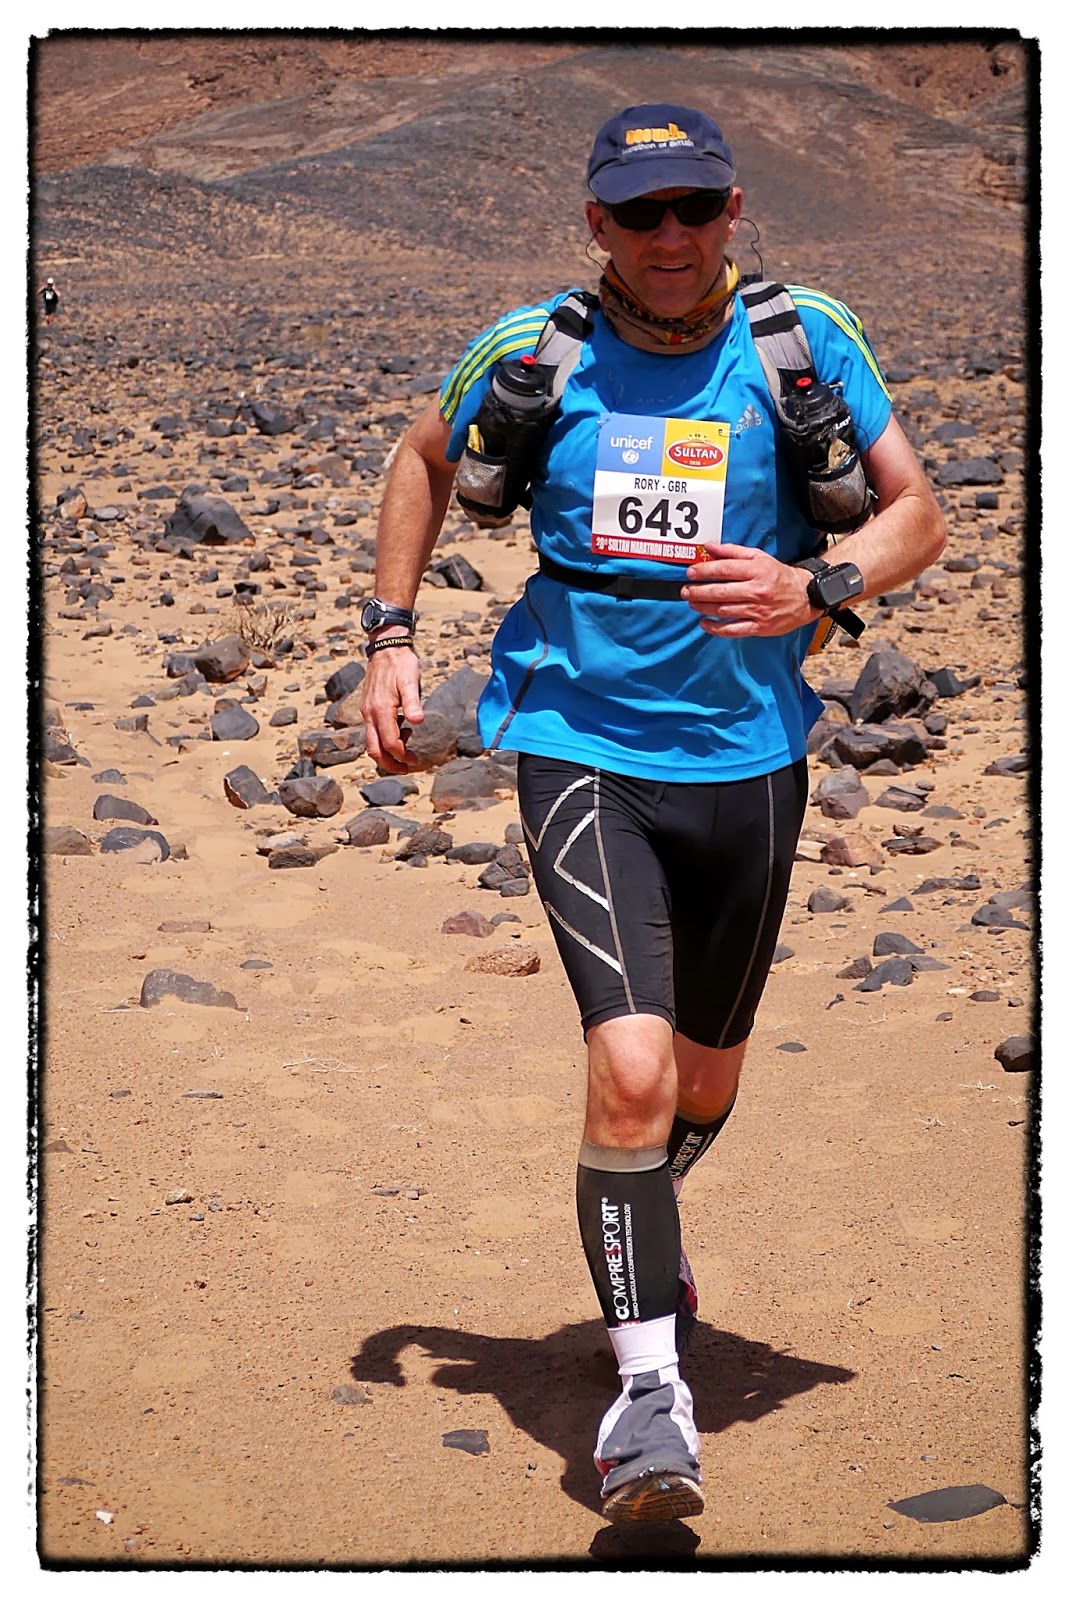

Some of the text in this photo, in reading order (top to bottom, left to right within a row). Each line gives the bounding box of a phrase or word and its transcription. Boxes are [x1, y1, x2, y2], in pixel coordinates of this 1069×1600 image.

[610, 435, 653, 450] unicef
[673, 445, 718, 459] SULTAN
[634, 477, 660, 491] RORY
[668, 480, 687, 493] GBR
[618, 496, 699, 539] 643
[608, 538, 629, 553] SULTAN
[629, 540, 662, 556] MARATHON
[662, 544, 674, 557] DES
[674, 545, 696, 559] SABLES
[626, 1236, 635, 1272] COMPRESSION
